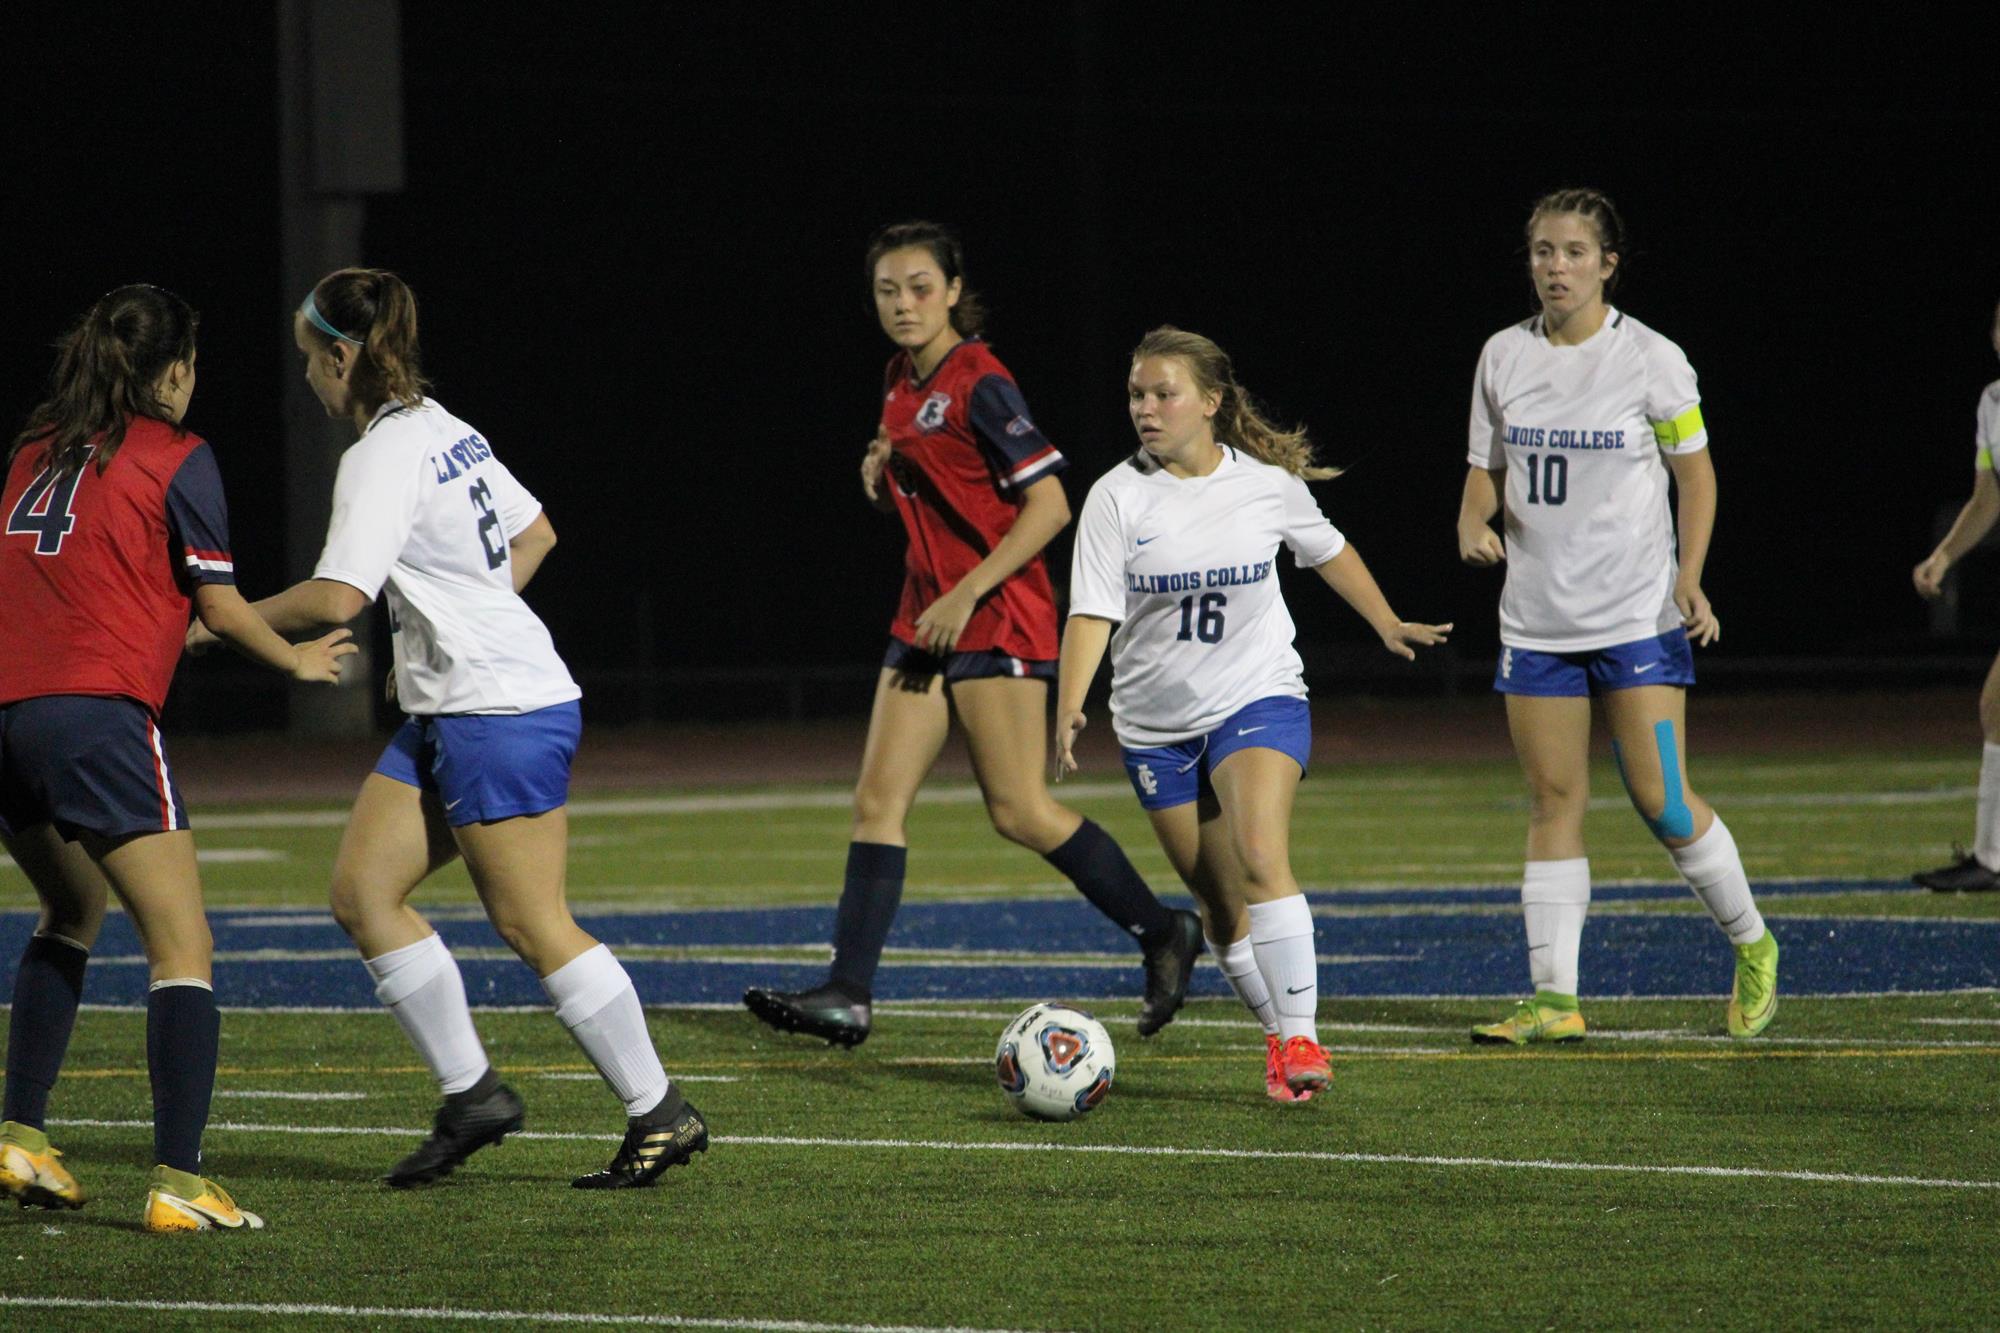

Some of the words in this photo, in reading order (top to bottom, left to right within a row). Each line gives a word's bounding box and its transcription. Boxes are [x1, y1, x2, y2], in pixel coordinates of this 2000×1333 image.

[1548, 429, 1625, 450] COLLEGE
[5, 444, 96, 556] 4
[1527, 453, 1568, 506] 10
[1206, 559, 1273, 588] COLLEG
[1176, 592, 1228, 644] 16
